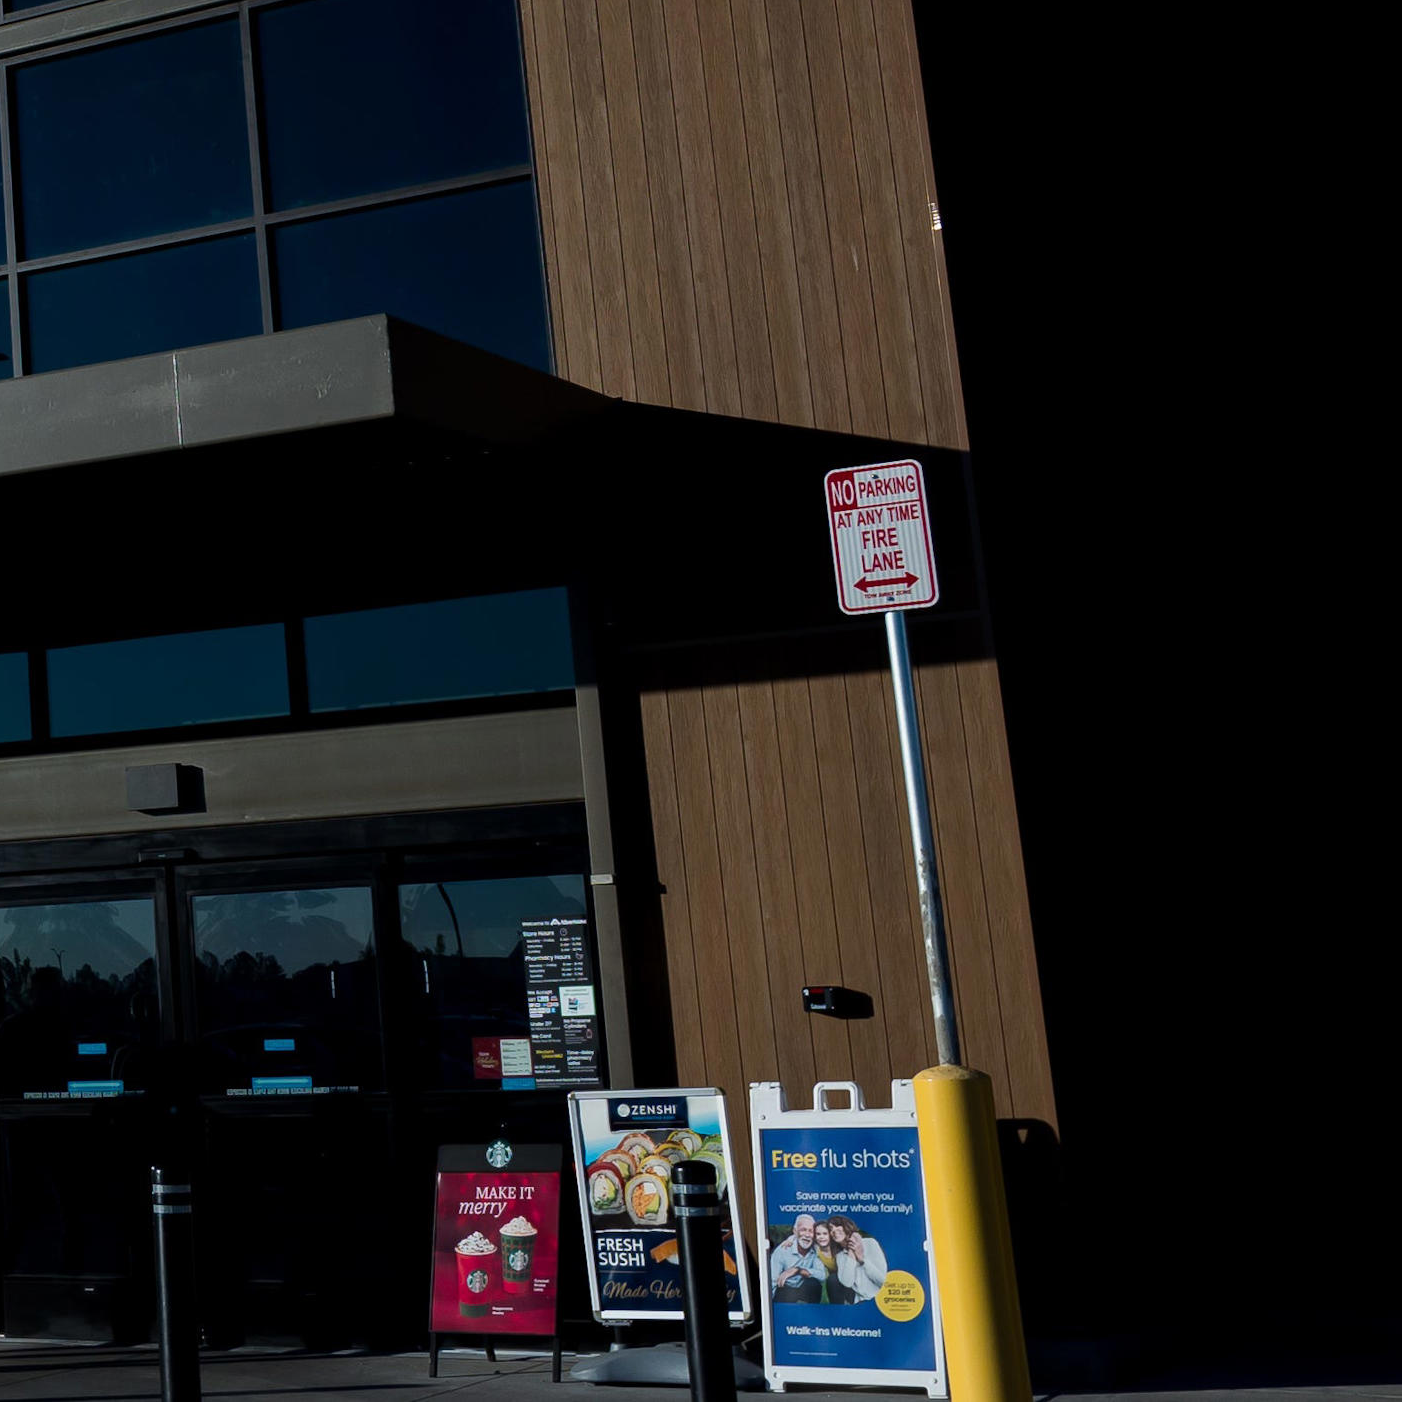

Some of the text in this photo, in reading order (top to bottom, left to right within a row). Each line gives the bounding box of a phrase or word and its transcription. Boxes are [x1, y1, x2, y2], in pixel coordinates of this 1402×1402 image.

[831, 475, 916, 507] NO PARKING
[837, 503, 920, 528] AT ANY TIME
[861, 527, 899, 549] FIRE
[861, 550, 905, 573] LANE
[630, 1104, 676, 1116] ZENSHI
[771, 1150, 818, 1168] Free
[820, 1148, 846, 1168] flu
[475, 1186, 534, 1200] MAKE IT
[796, 1191, 894, 1203] Save more when you
[458, 1201, 508, 1218] merry
[780, 1202, 914, 1215] vaccinate your whole family!
[598, 1238, 644, 1252] FRESH
[598, 1252, 646, 1267] SUSHI
[603, 1280, 682, 1299] Made Her
[884, 1296, 916, 1304] groceries
[786, 1326, 882, 1338] Walk-Ins Welcome!
